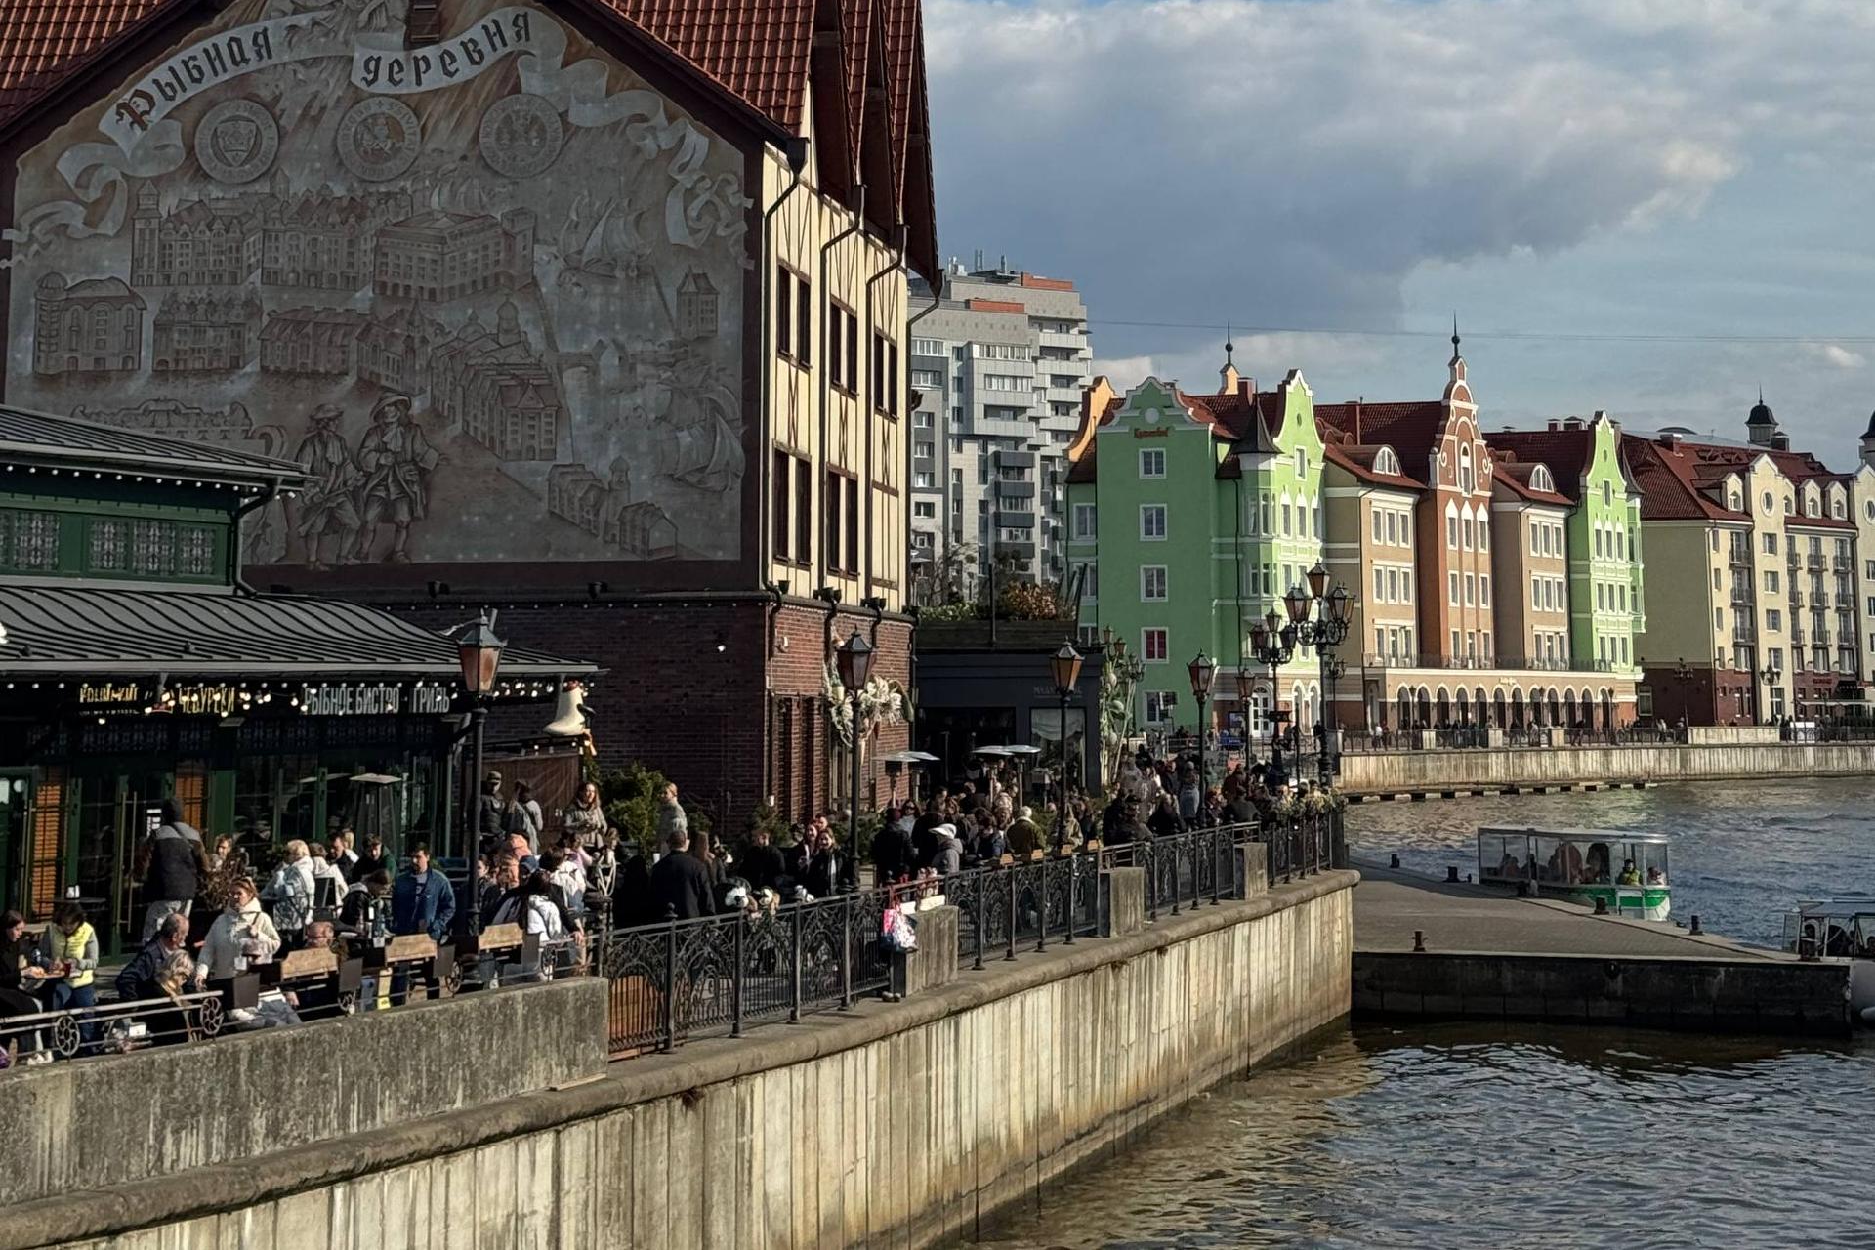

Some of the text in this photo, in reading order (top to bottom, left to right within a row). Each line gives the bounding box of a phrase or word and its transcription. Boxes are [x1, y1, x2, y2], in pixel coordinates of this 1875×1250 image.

[115, 11, 531, 132] Рыбная деревня
[179, 686, 235, 714] ЧЕБУРЕКИ
[304, 687, 450, 716] РЫБНОЕ БИСТРО ГРИЛЬ
